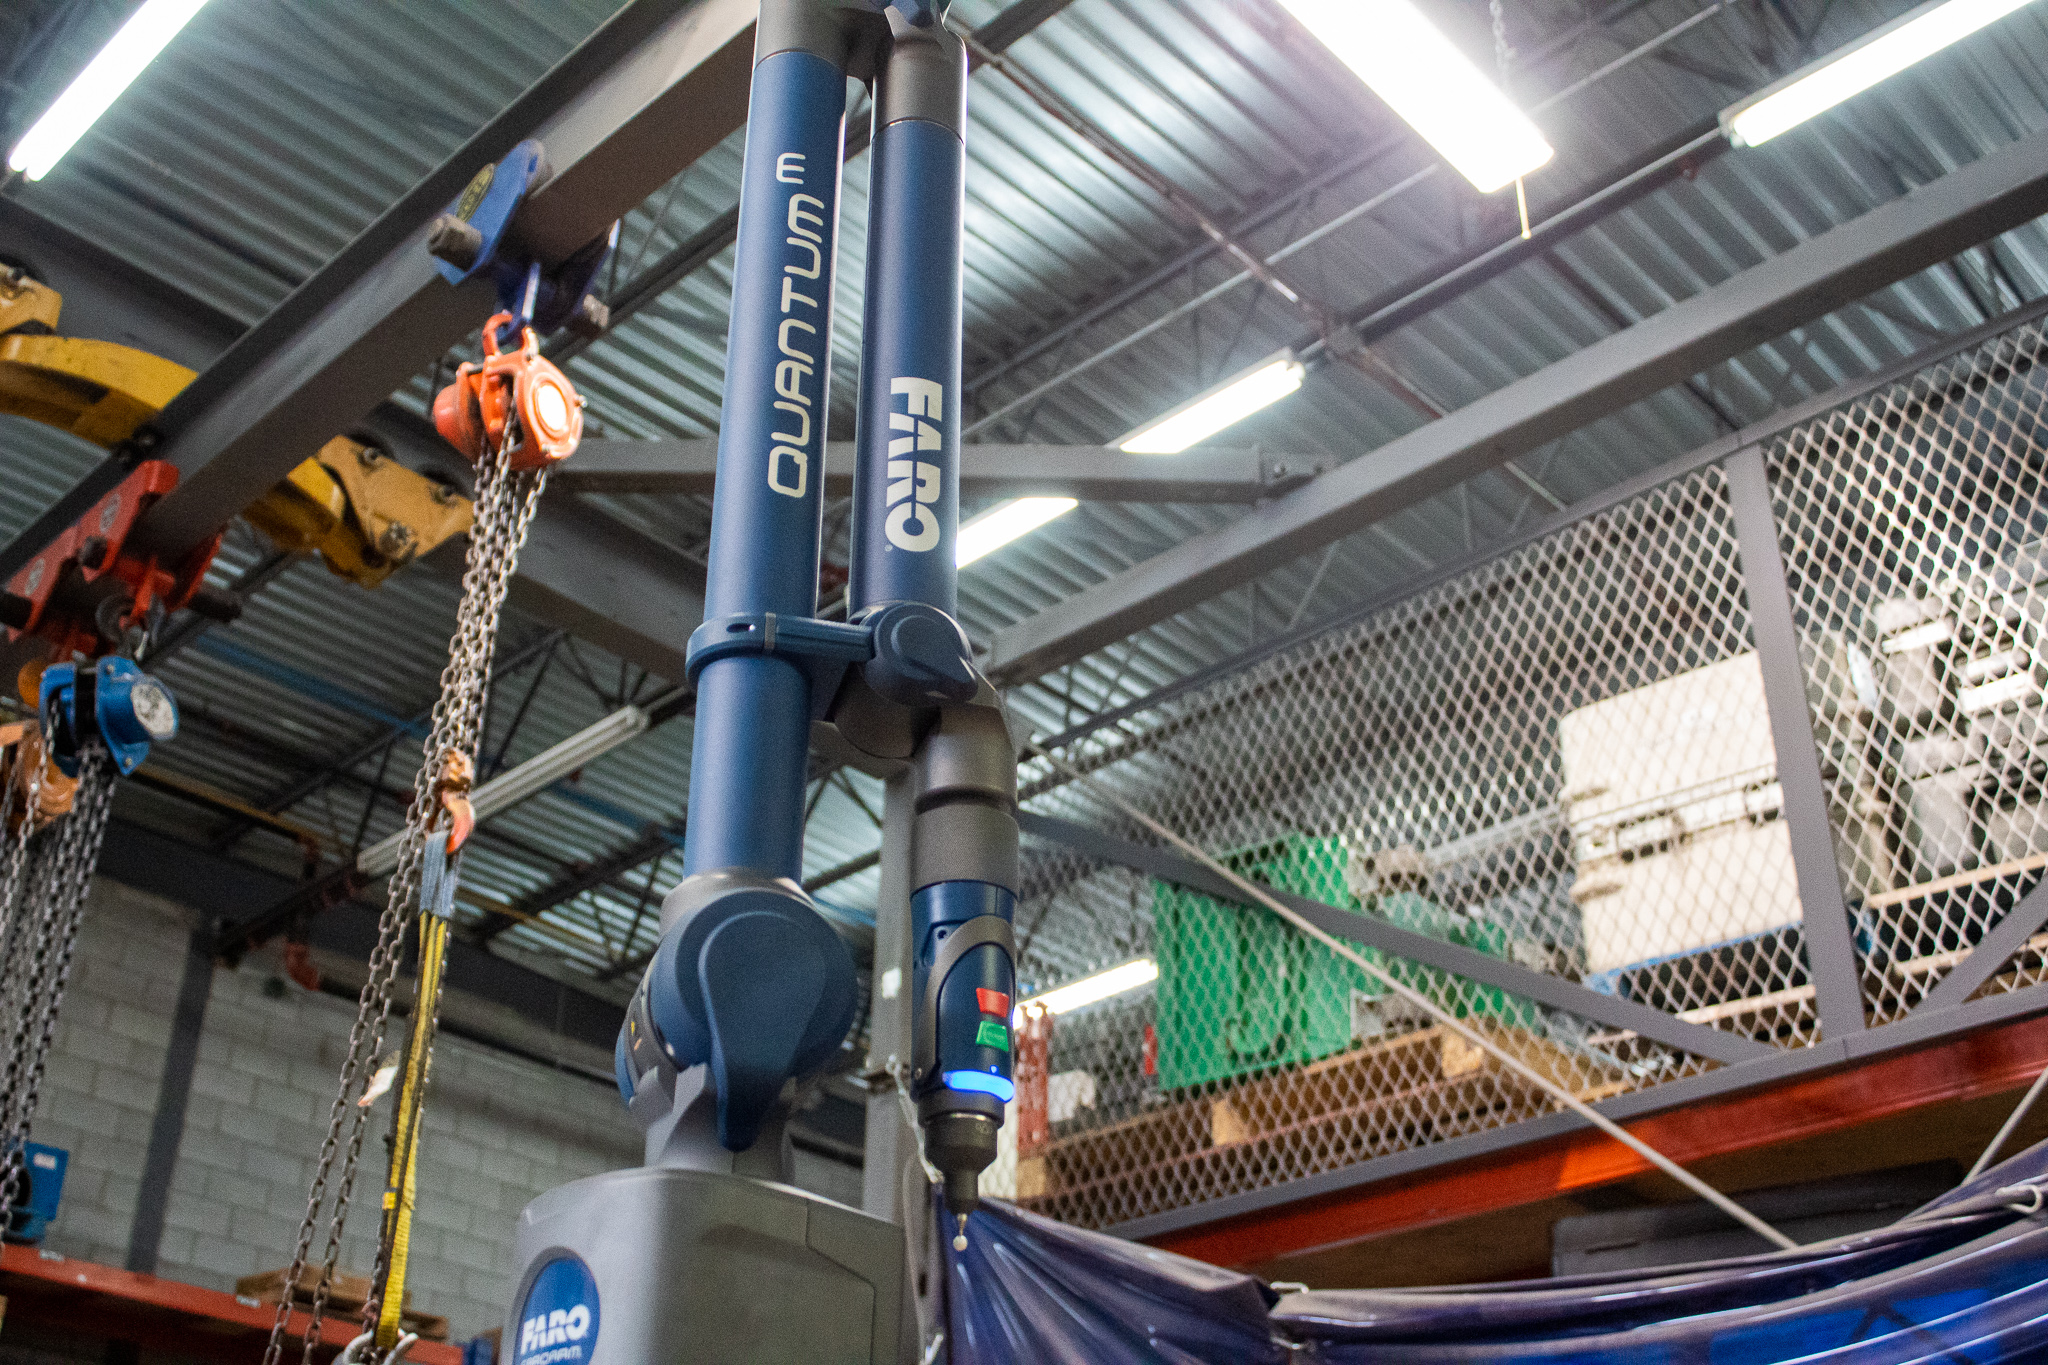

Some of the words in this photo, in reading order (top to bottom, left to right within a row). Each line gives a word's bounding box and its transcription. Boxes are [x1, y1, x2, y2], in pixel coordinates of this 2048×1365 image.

[768, 193, 825, 498] QUANTUM
[885, 377, 943, 552] FARO
[520, 1304, 590, 1355] FARO
